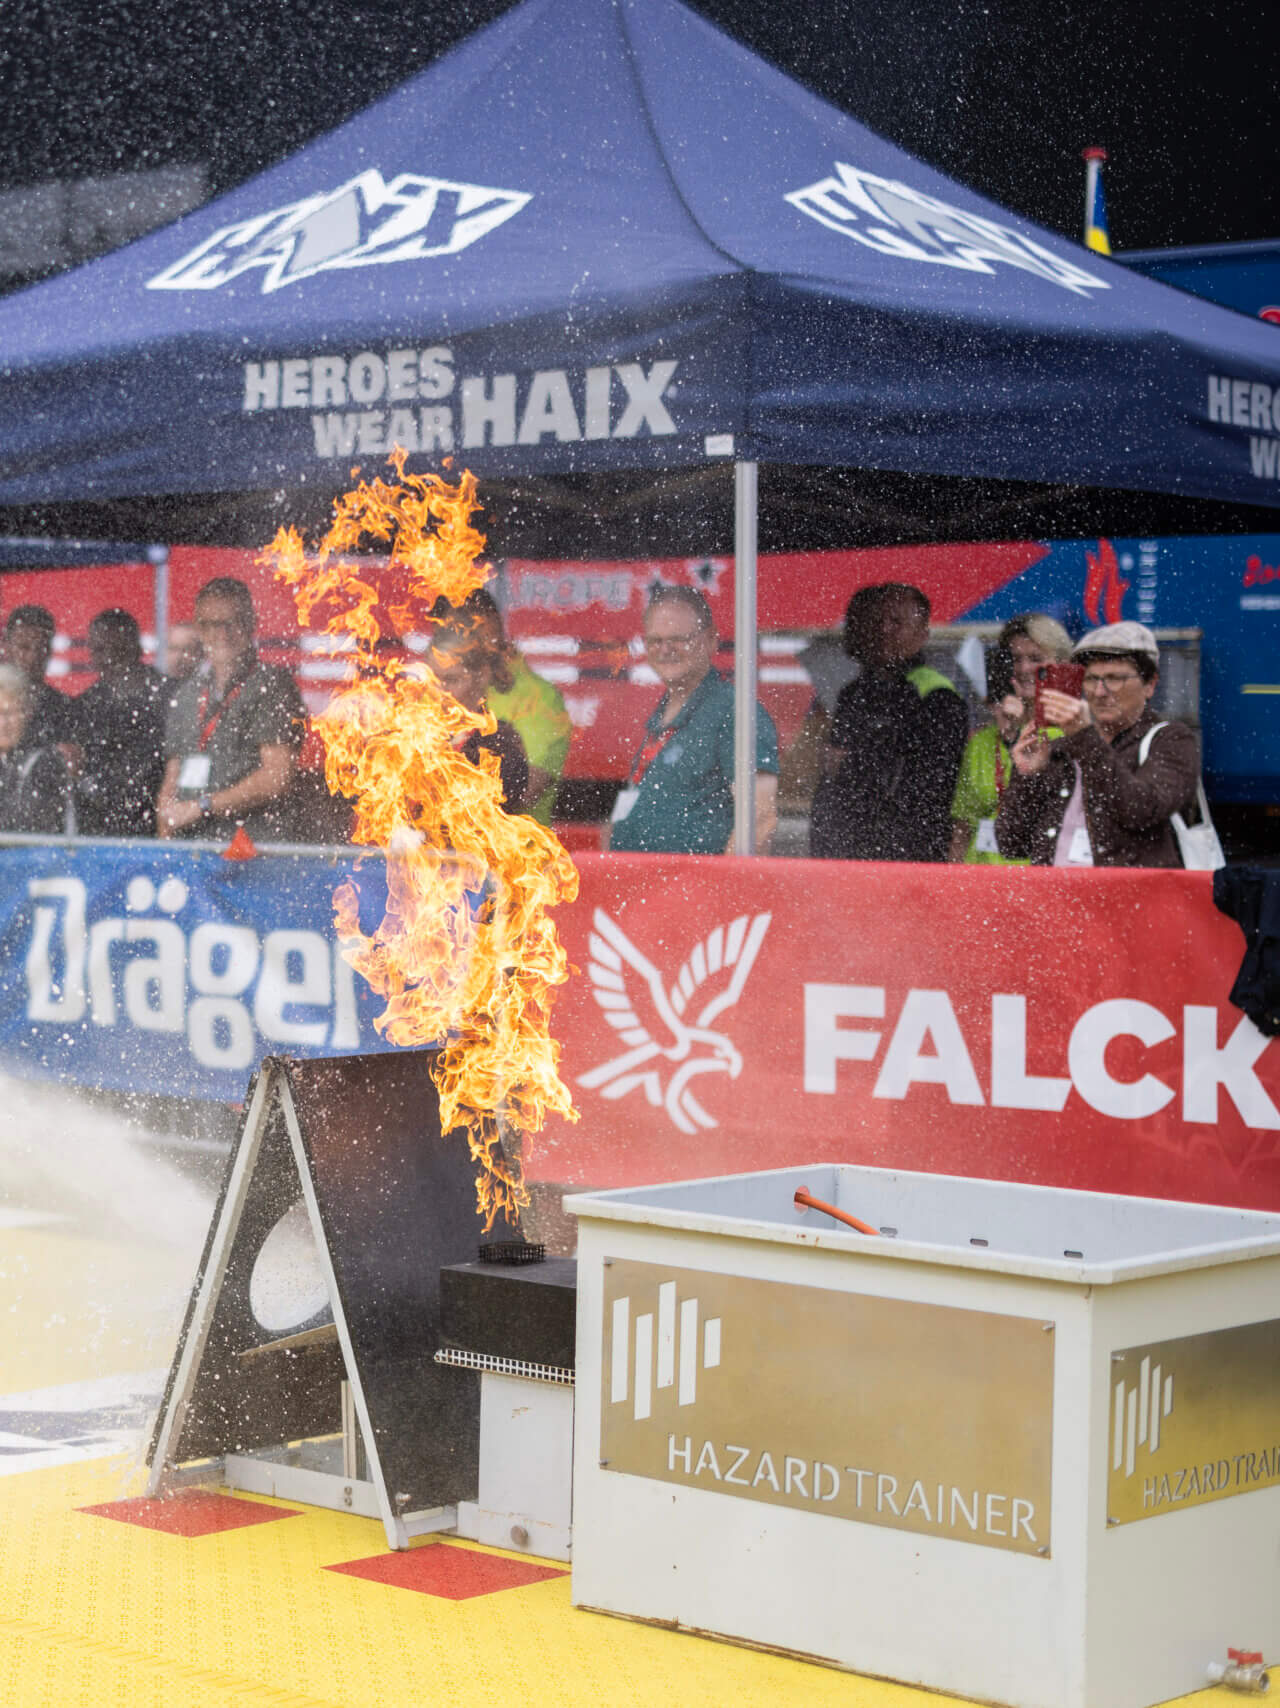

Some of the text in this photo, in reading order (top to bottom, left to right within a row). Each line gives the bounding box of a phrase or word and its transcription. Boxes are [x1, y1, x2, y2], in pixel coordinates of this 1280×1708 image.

[243, 346, 455, 411] HEROES
[312, 360, 679, 458] WEAR HAIX
[1208, 374, 1280, 431] HER
[1250, 434, 1280, 480] W
[27, 876, 362, 1070] Dräger
[803, 983, 1280, 1130] FALCK
[1143, 1444, 1280, 1512] HAZARDTRAI
